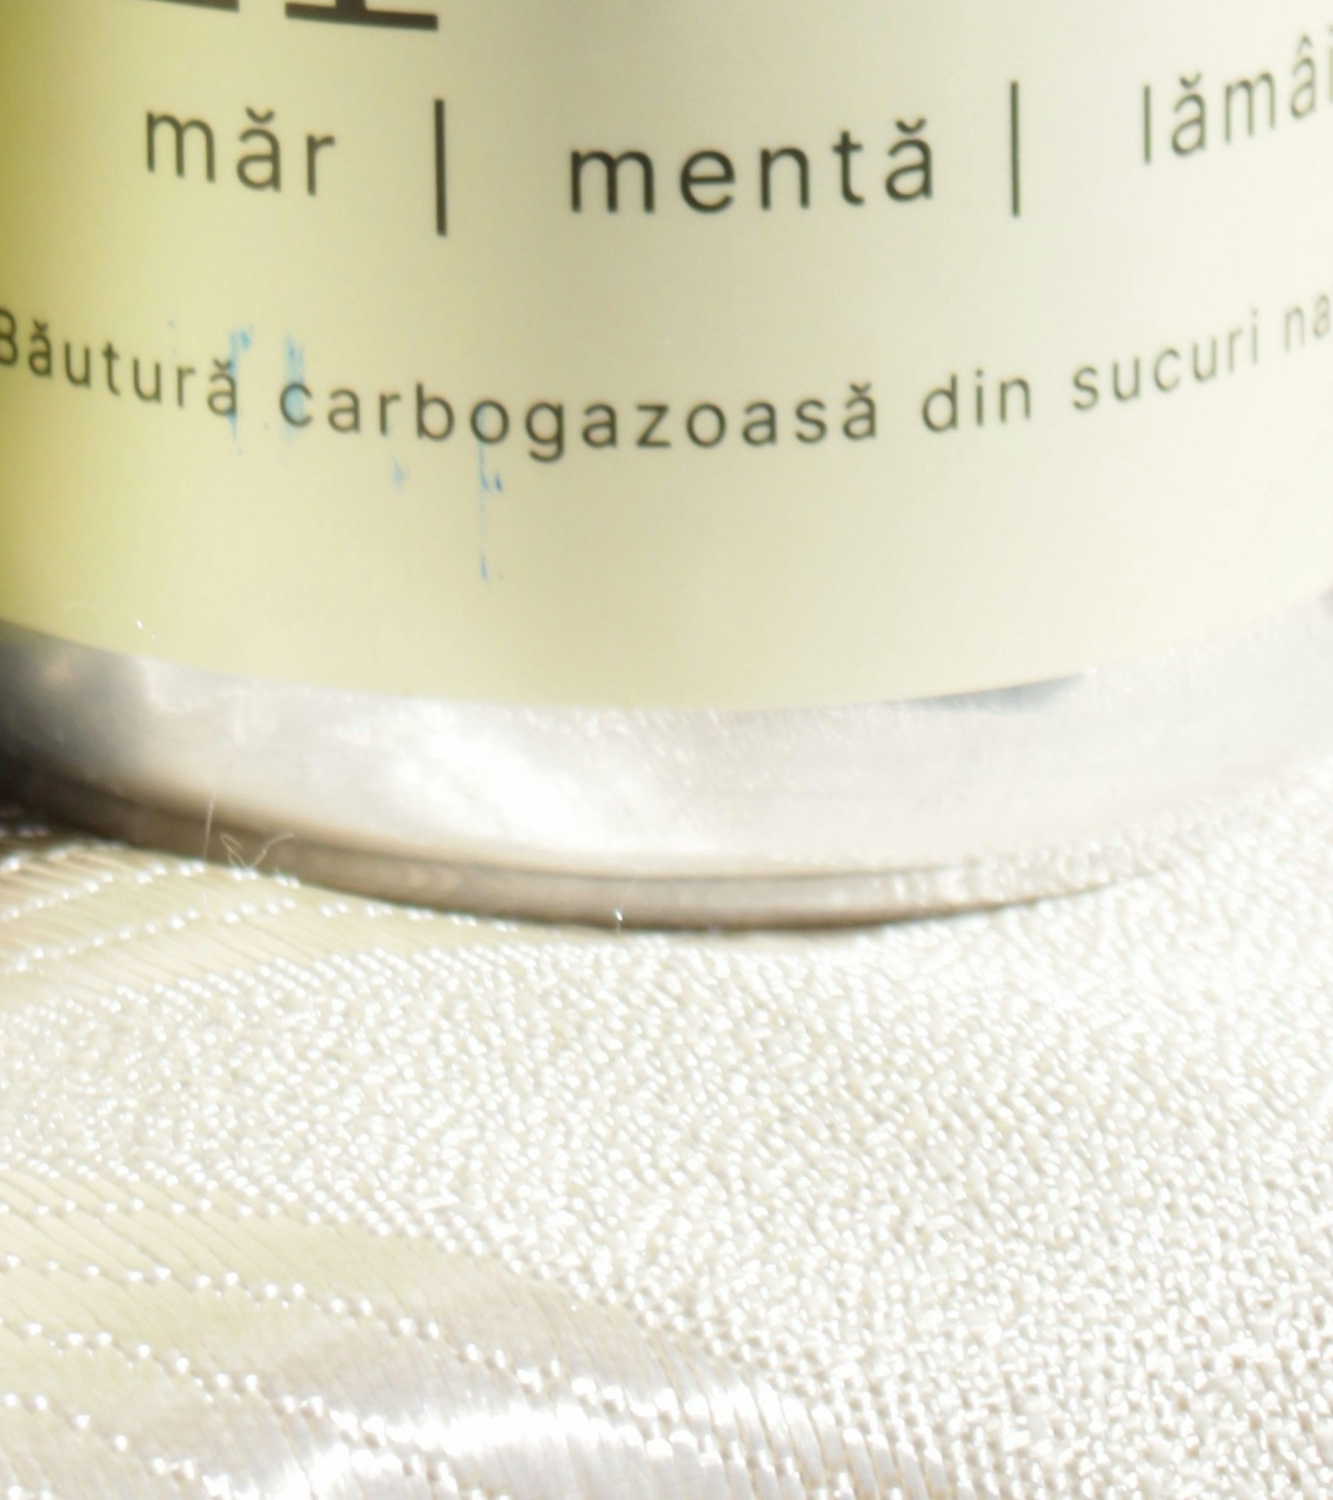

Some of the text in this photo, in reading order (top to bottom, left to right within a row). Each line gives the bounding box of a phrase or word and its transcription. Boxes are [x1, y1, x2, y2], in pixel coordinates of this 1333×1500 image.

[144, 105, 338, 198] măr
[570, 117, 935, 214] mentă
[279, 379, 879, 464] carbogazoasă
[920, 367, 1033, 437] din
[1071, 307, 1260, 412] sucuri
